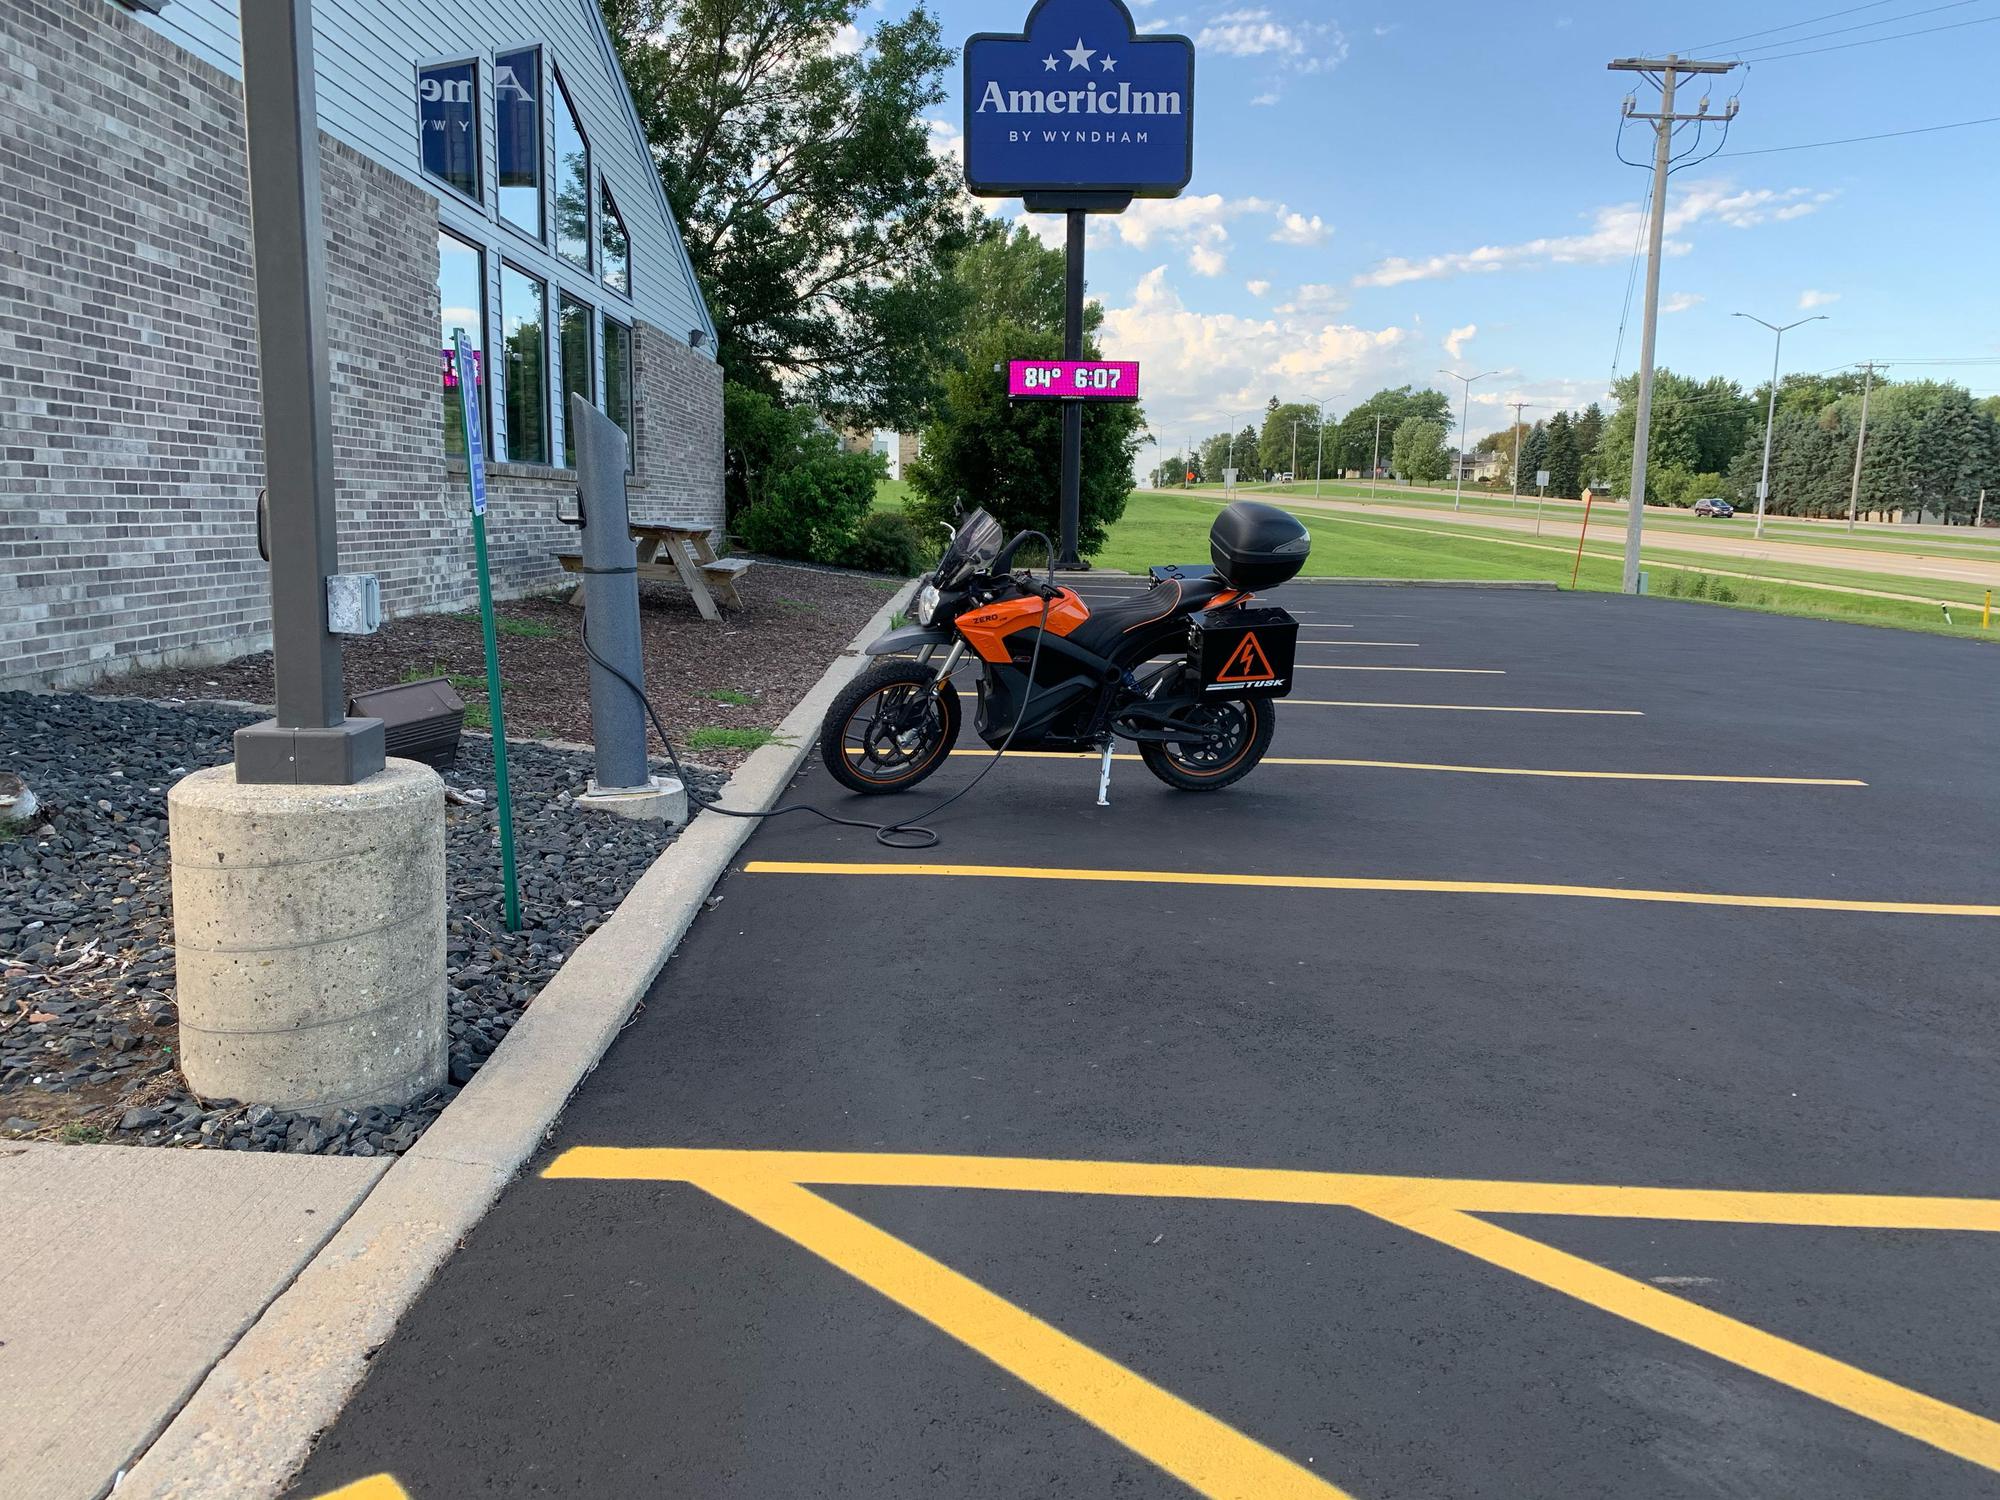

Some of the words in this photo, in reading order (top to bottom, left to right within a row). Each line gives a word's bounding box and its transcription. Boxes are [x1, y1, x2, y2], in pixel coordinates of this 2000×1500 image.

[976, 81, 1182, 115] AmericInn
[1009, 131, 1032, 142] BY
[1043, 131, 1149, 143] WYNDHAM
[1075, 368, 1121, 389] 6:07
[972, 613, 998, 625] ZERO
[1246, 679, 1286, 688] TUSK
